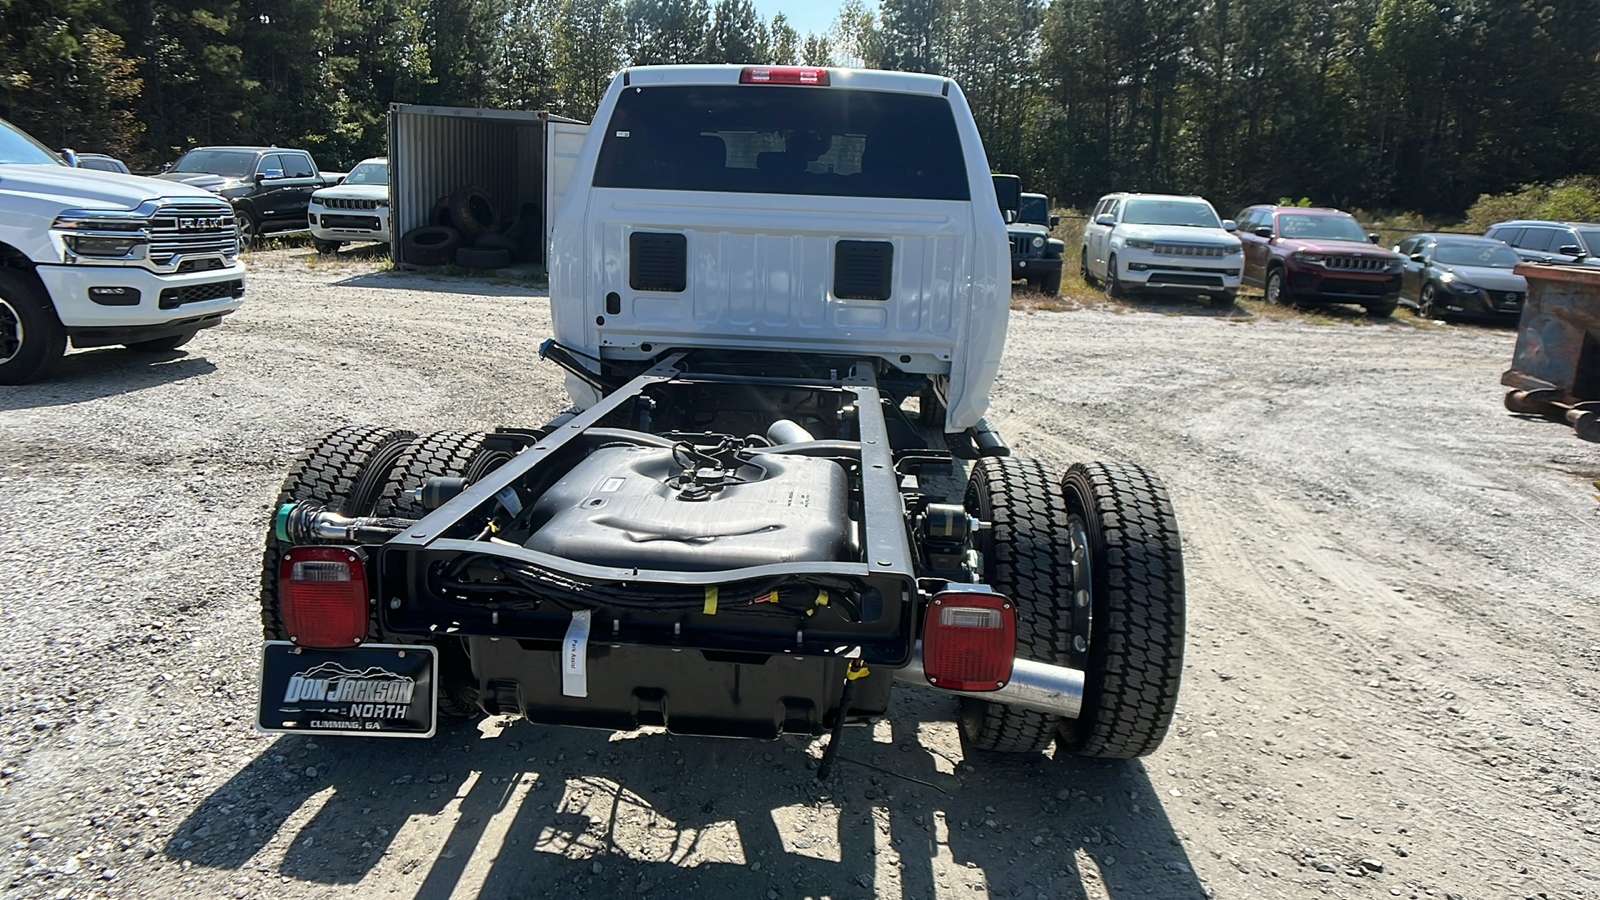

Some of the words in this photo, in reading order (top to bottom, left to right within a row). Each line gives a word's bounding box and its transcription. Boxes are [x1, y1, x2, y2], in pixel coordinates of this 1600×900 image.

[179, 217, 224, 229] RAM
[283, 676, 329, 703] DON
[326, 678, 415, 704] JACKSON
[349, 704, 407, 719] NORTH
[310, 720, 362, 730] CUMMING,
[365, 721, 381, 730] GA
